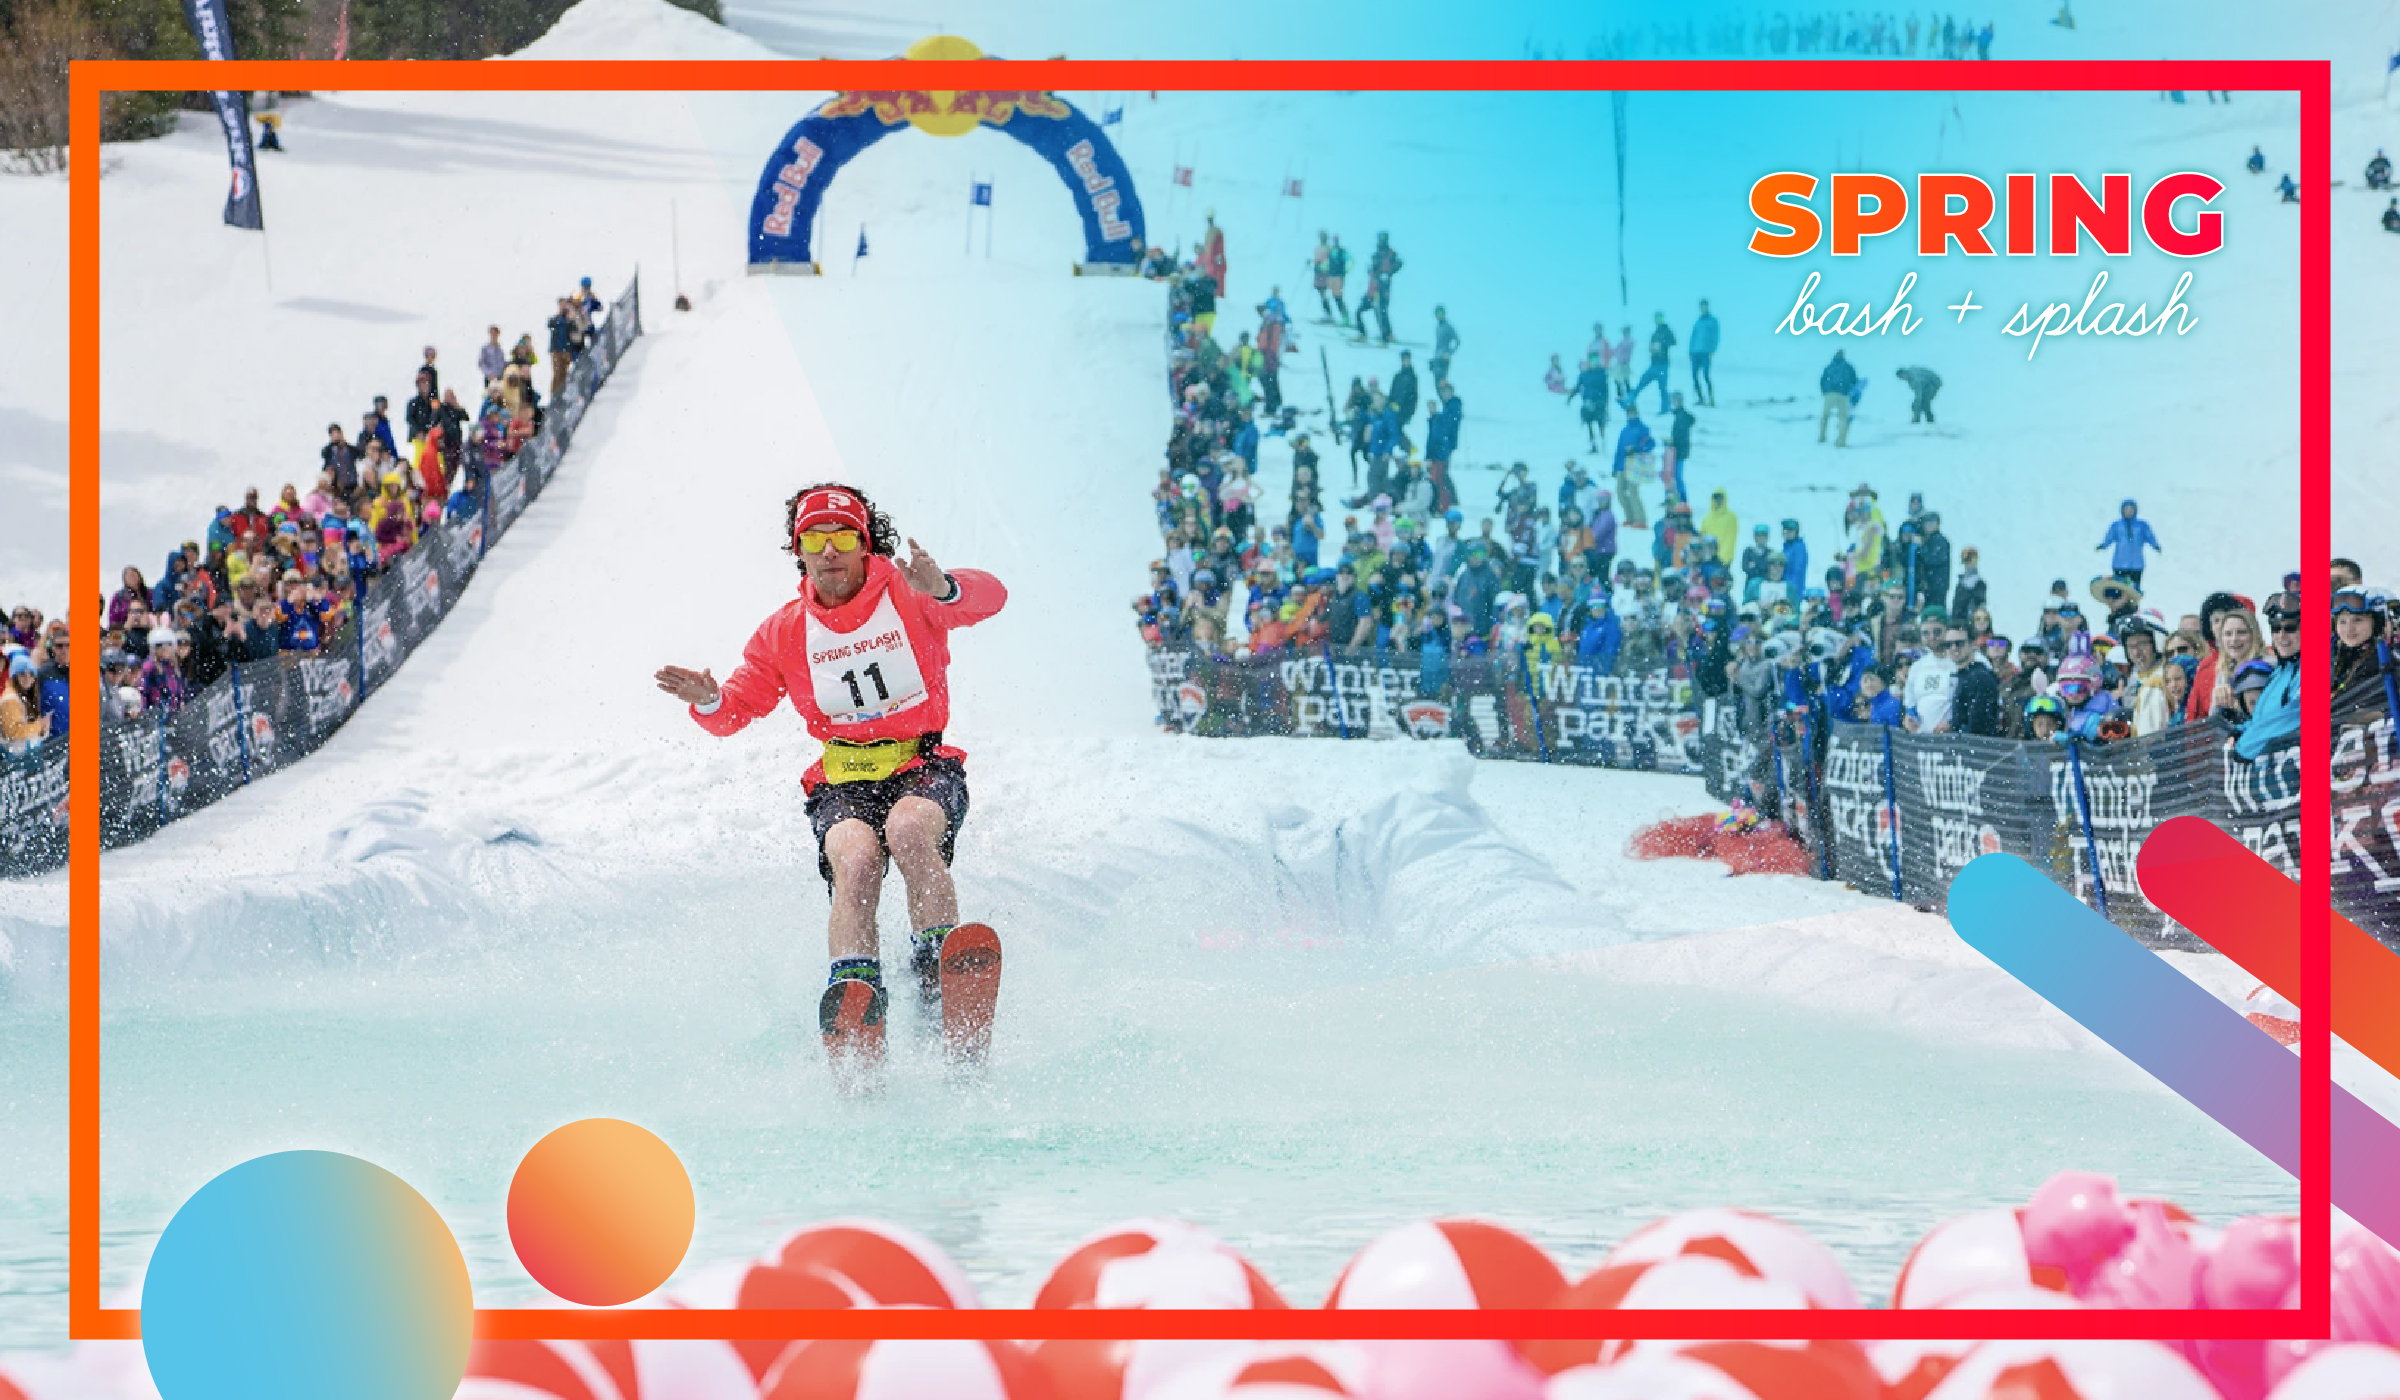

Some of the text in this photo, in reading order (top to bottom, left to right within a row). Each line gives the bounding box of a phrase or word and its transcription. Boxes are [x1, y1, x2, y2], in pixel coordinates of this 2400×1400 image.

[763, 137, 823, 236] Red Bull
[1066, 140, 1132, 241] Red Bull
[813, 629, 902, 664] SPRING SPLASH
[841, 662, 890, 708] 11
[1281, 656, 1421, 698] Winter
[1536, 663, 1692, 708] Winter
[1825, 736, 1885, 793] inter
